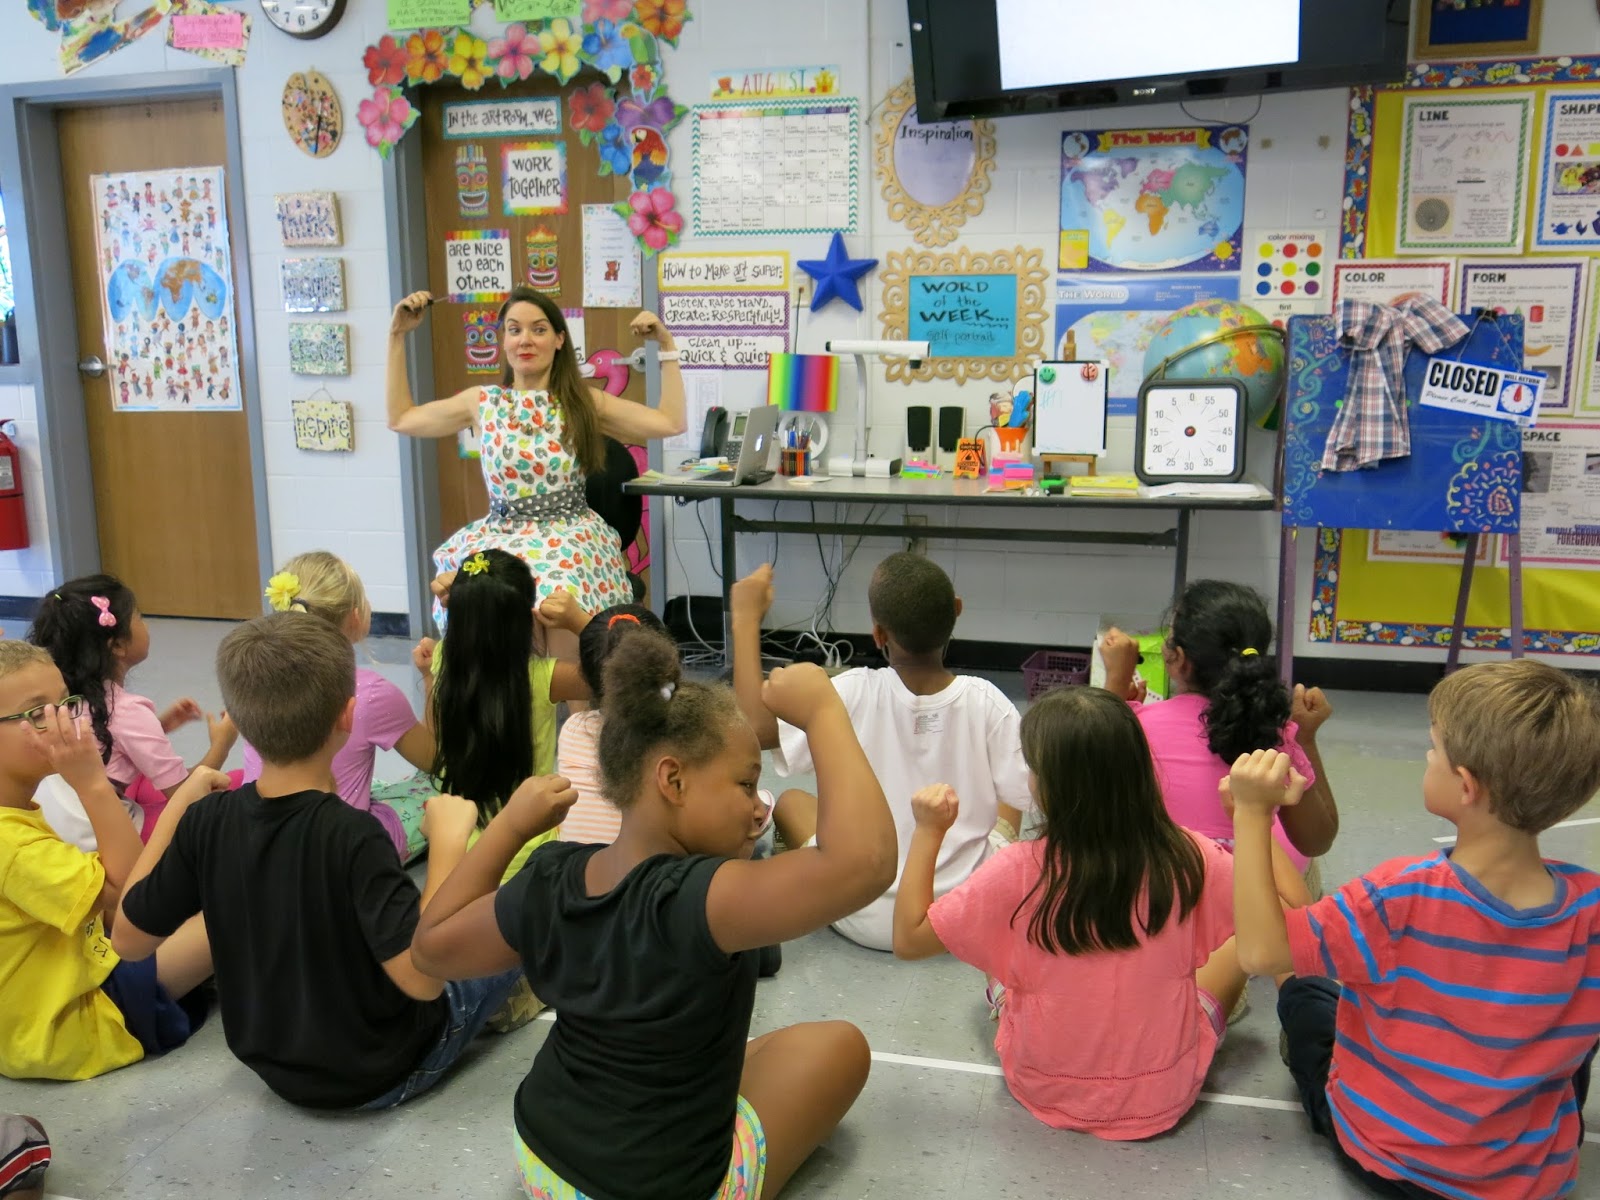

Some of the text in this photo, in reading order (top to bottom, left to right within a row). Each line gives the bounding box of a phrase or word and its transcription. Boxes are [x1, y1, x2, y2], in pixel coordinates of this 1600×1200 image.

[284, 11, 290, 23] 7
[298, 14, 305, 26] 6
[312, 9, 319, 20] 5
[1133, 88, 1156, 96] SONY
[461, 110, 478, 127] the
[1419, 110, 1449, 121] LINE
[901, 124, 973, 144] Inspiration
[1111, 131, 1197, 145] The World
[512, 156, 553, 172] WORK
[1268, 232, 1316, 242] color mixing
[458, 258, 505, 272] to each
[689, 266, 702, 280] to
[1345, 272, 1386, 283] COLOR
[1473, 273, 1506, 283] FORM
[922, 281, 989, 294] WORD
[1084, 289, 1126, 300] WORLD
[957, 295, 982, 307] the
[1429, 361, 1499, 397] CLOSED
[1171, 397, 1177, 406] 5
[1189, 392, 1195, 401] 0
[1205, 396, 1215, 405] 55
[1155, 410, 1164, 419] 10
[1218, 409, 1229, 418] 50
[1149, 428, 1159, 437] 15
[1222, 427, 1233, 436] 45
[1523, 431, 1561, 442] SPACE
[1152, 444, 1162, 453] 20
[1216, 444, 1227, 453] 40
[1166, 457, 1176, 467] 25
[1183, 462, 1194, 471] 30
[1203, 457, 1213, 467] 35
